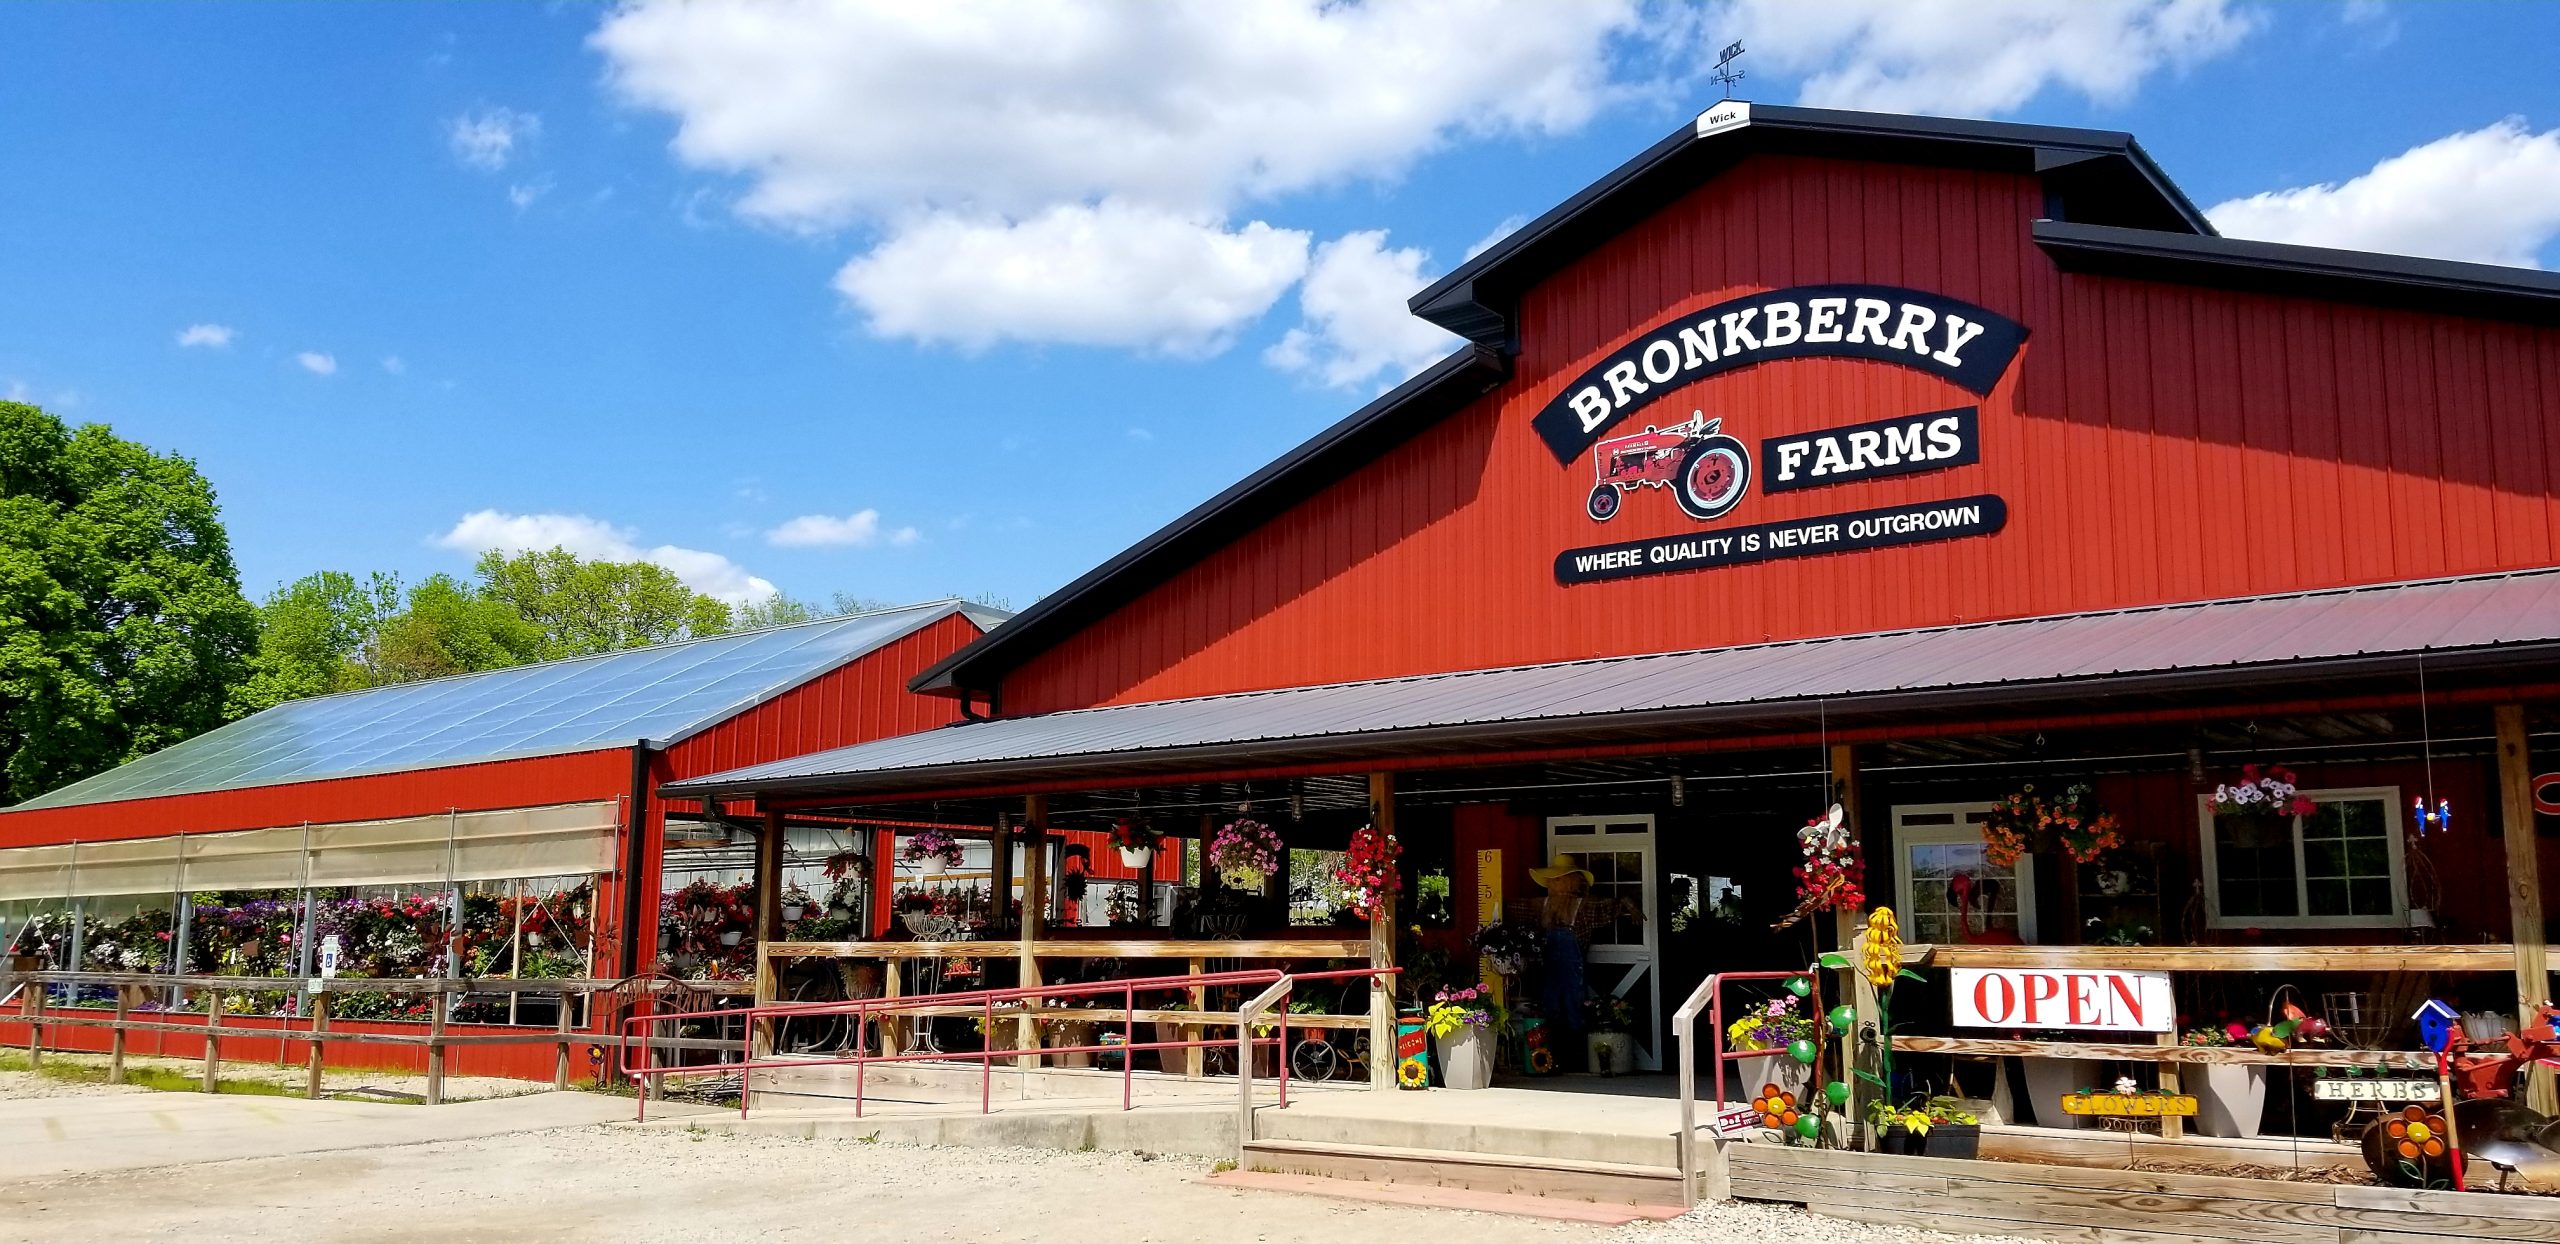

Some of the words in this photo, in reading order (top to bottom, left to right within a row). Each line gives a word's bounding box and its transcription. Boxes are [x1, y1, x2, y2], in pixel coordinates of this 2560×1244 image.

[1720, 39, 1743, 63] WICK
[1710, 111, 1736, 125] Wick
[1568, 297, 1985, 433] BRONKBERRY
[1777, 416, 1962, 480] FARMS
[1576, 549, 1643, 573] WHERE
[1650, 537, 1733, 564] QUALITY
[1741, 533, 1760, 553] IS
[1769, 523, 1839, 549] NEVER
[1848, 505, 1981, 539] OUTGROWN
[1484, 851, 1492, 863] 6
[1485, 887, 1492, 899] 5
[1974, 972, 2146, 1027] OPEN
[2327, 1082, 2427, 1099] HERBS
[2074, 1095, 2187, 1113] FLOWERS
